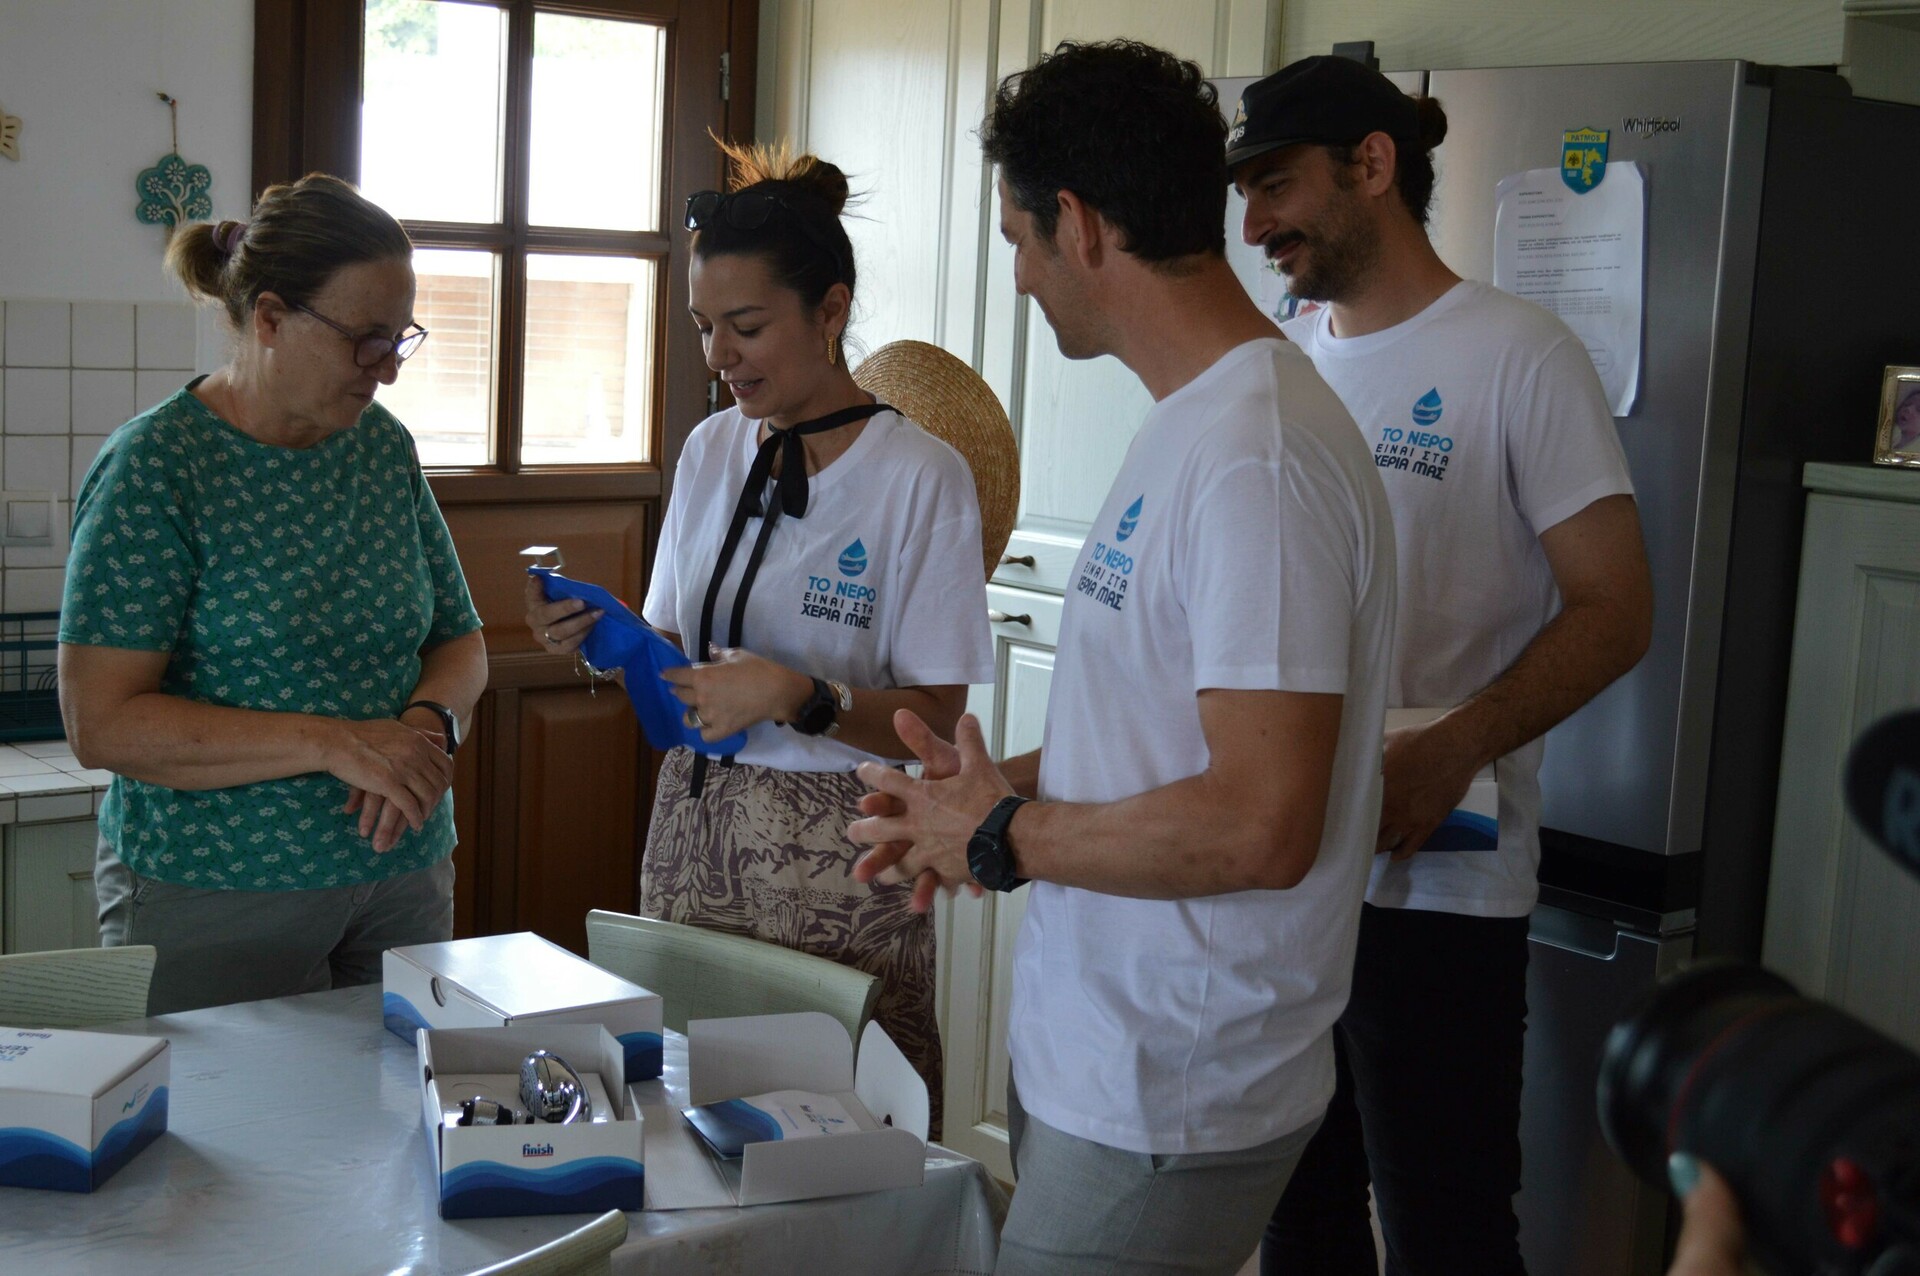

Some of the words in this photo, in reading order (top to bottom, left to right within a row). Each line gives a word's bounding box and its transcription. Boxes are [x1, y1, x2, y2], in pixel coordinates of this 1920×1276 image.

[1622, 117, 1680, 136] Whirlpool
[1382, 427, 1403, 442] ΤΟ
[1406, 430, 1453, 452] ΝΕΡΟ
[1376, 443, 1415, 457] ΕΙΝΑΙ
[1422, 450, 1449, 466] ΣΤΑ
[1412, 460, 1446, 481] ΜΑΣ
[1091, 542, 1106, 560] ΤΟ
[1102, 547, 1134, 575] ΝΕΡΟ
[808, 576, 831, 592] ΤΟ
[835, 581, 877, 603] ΝΕΡΟ
[1083, 561, 1106, 580] ΕΙΝΑΙ
[1107, 573, 1128, 593] ΣΤΑ
[803, 592, 844, 609] ΕΙΝΑΙ
[852, 602, 874, 616] ΣΤΑ
[1095, 586, 1124, 611] ΜΑΣ
[801, 603, 840, 623] ΧΕΡΙΑ
[844, 612, 871, 629] ΜΑΣ
[523, 1143, 554, 1156] finish
